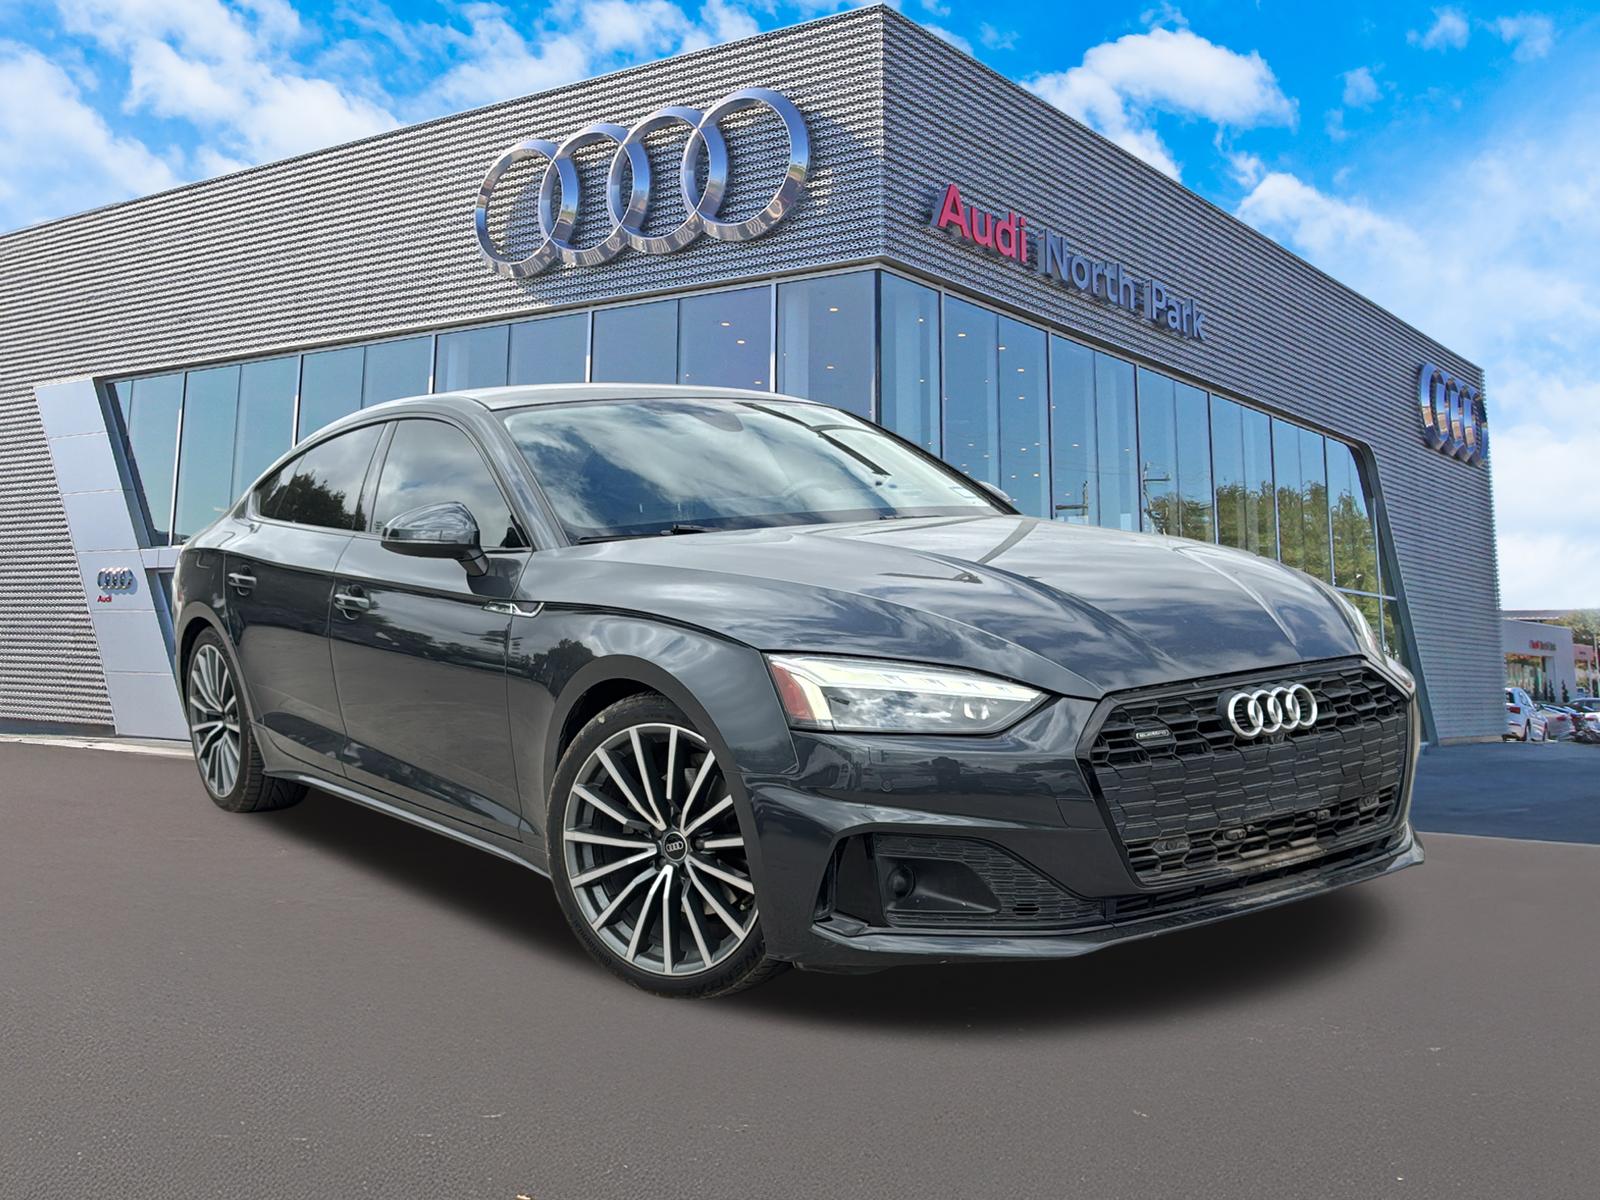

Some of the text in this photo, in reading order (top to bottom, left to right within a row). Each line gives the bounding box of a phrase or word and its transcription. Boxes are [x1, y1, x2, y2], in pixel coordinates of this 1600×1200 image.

[935, 183, 1205, 340] Audi North Park
